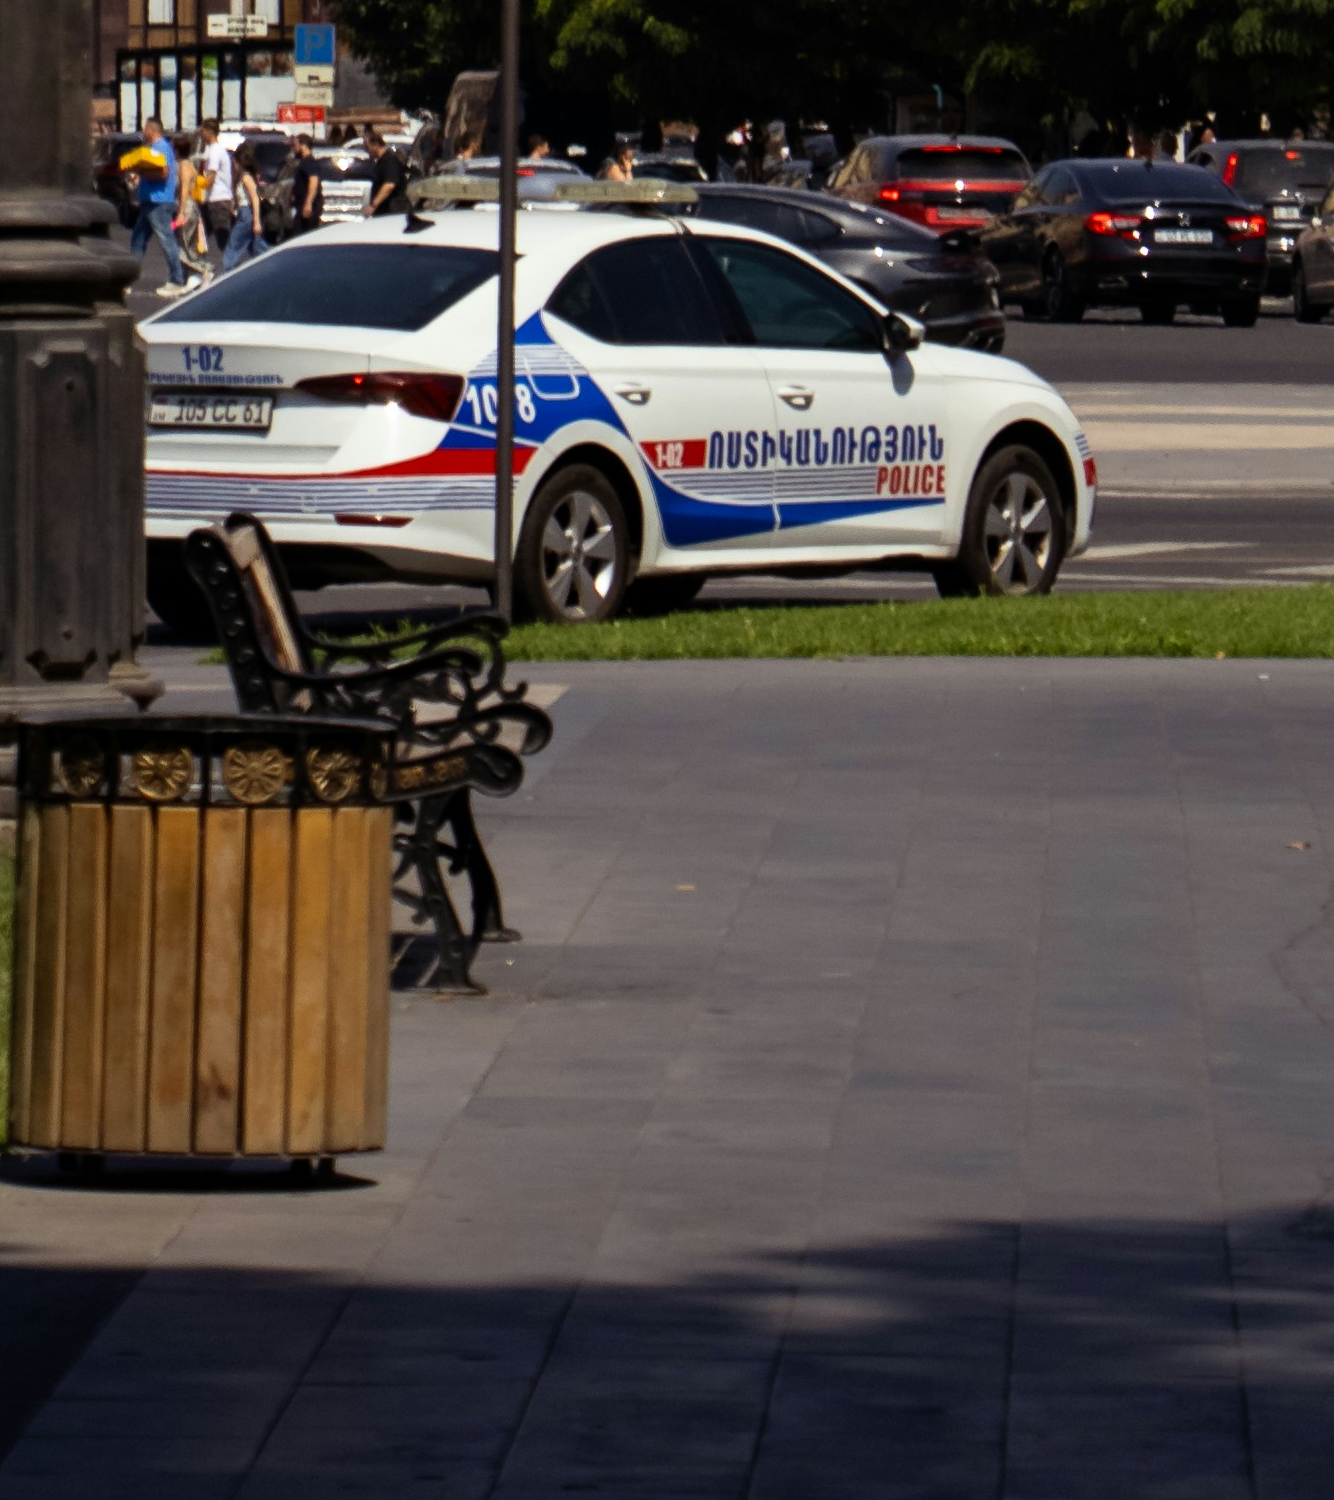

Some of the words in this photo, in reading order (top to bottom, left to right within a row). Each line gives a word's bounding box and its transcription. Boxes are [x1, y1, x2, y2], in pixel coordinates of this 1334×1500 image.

[305, 28, 326, 60] P
[182, 345, 224, 372] 1-02
[175, 397, 207, 422] 105
[213, 399, 237, 423] CC
[655, 442, 684, 468] 1-02
[709, 424, 944, 469] ՈՍՏԻԿԱՆՈՒԹՅՈՒՆ
[875, 464, 946, 495] POLICE
